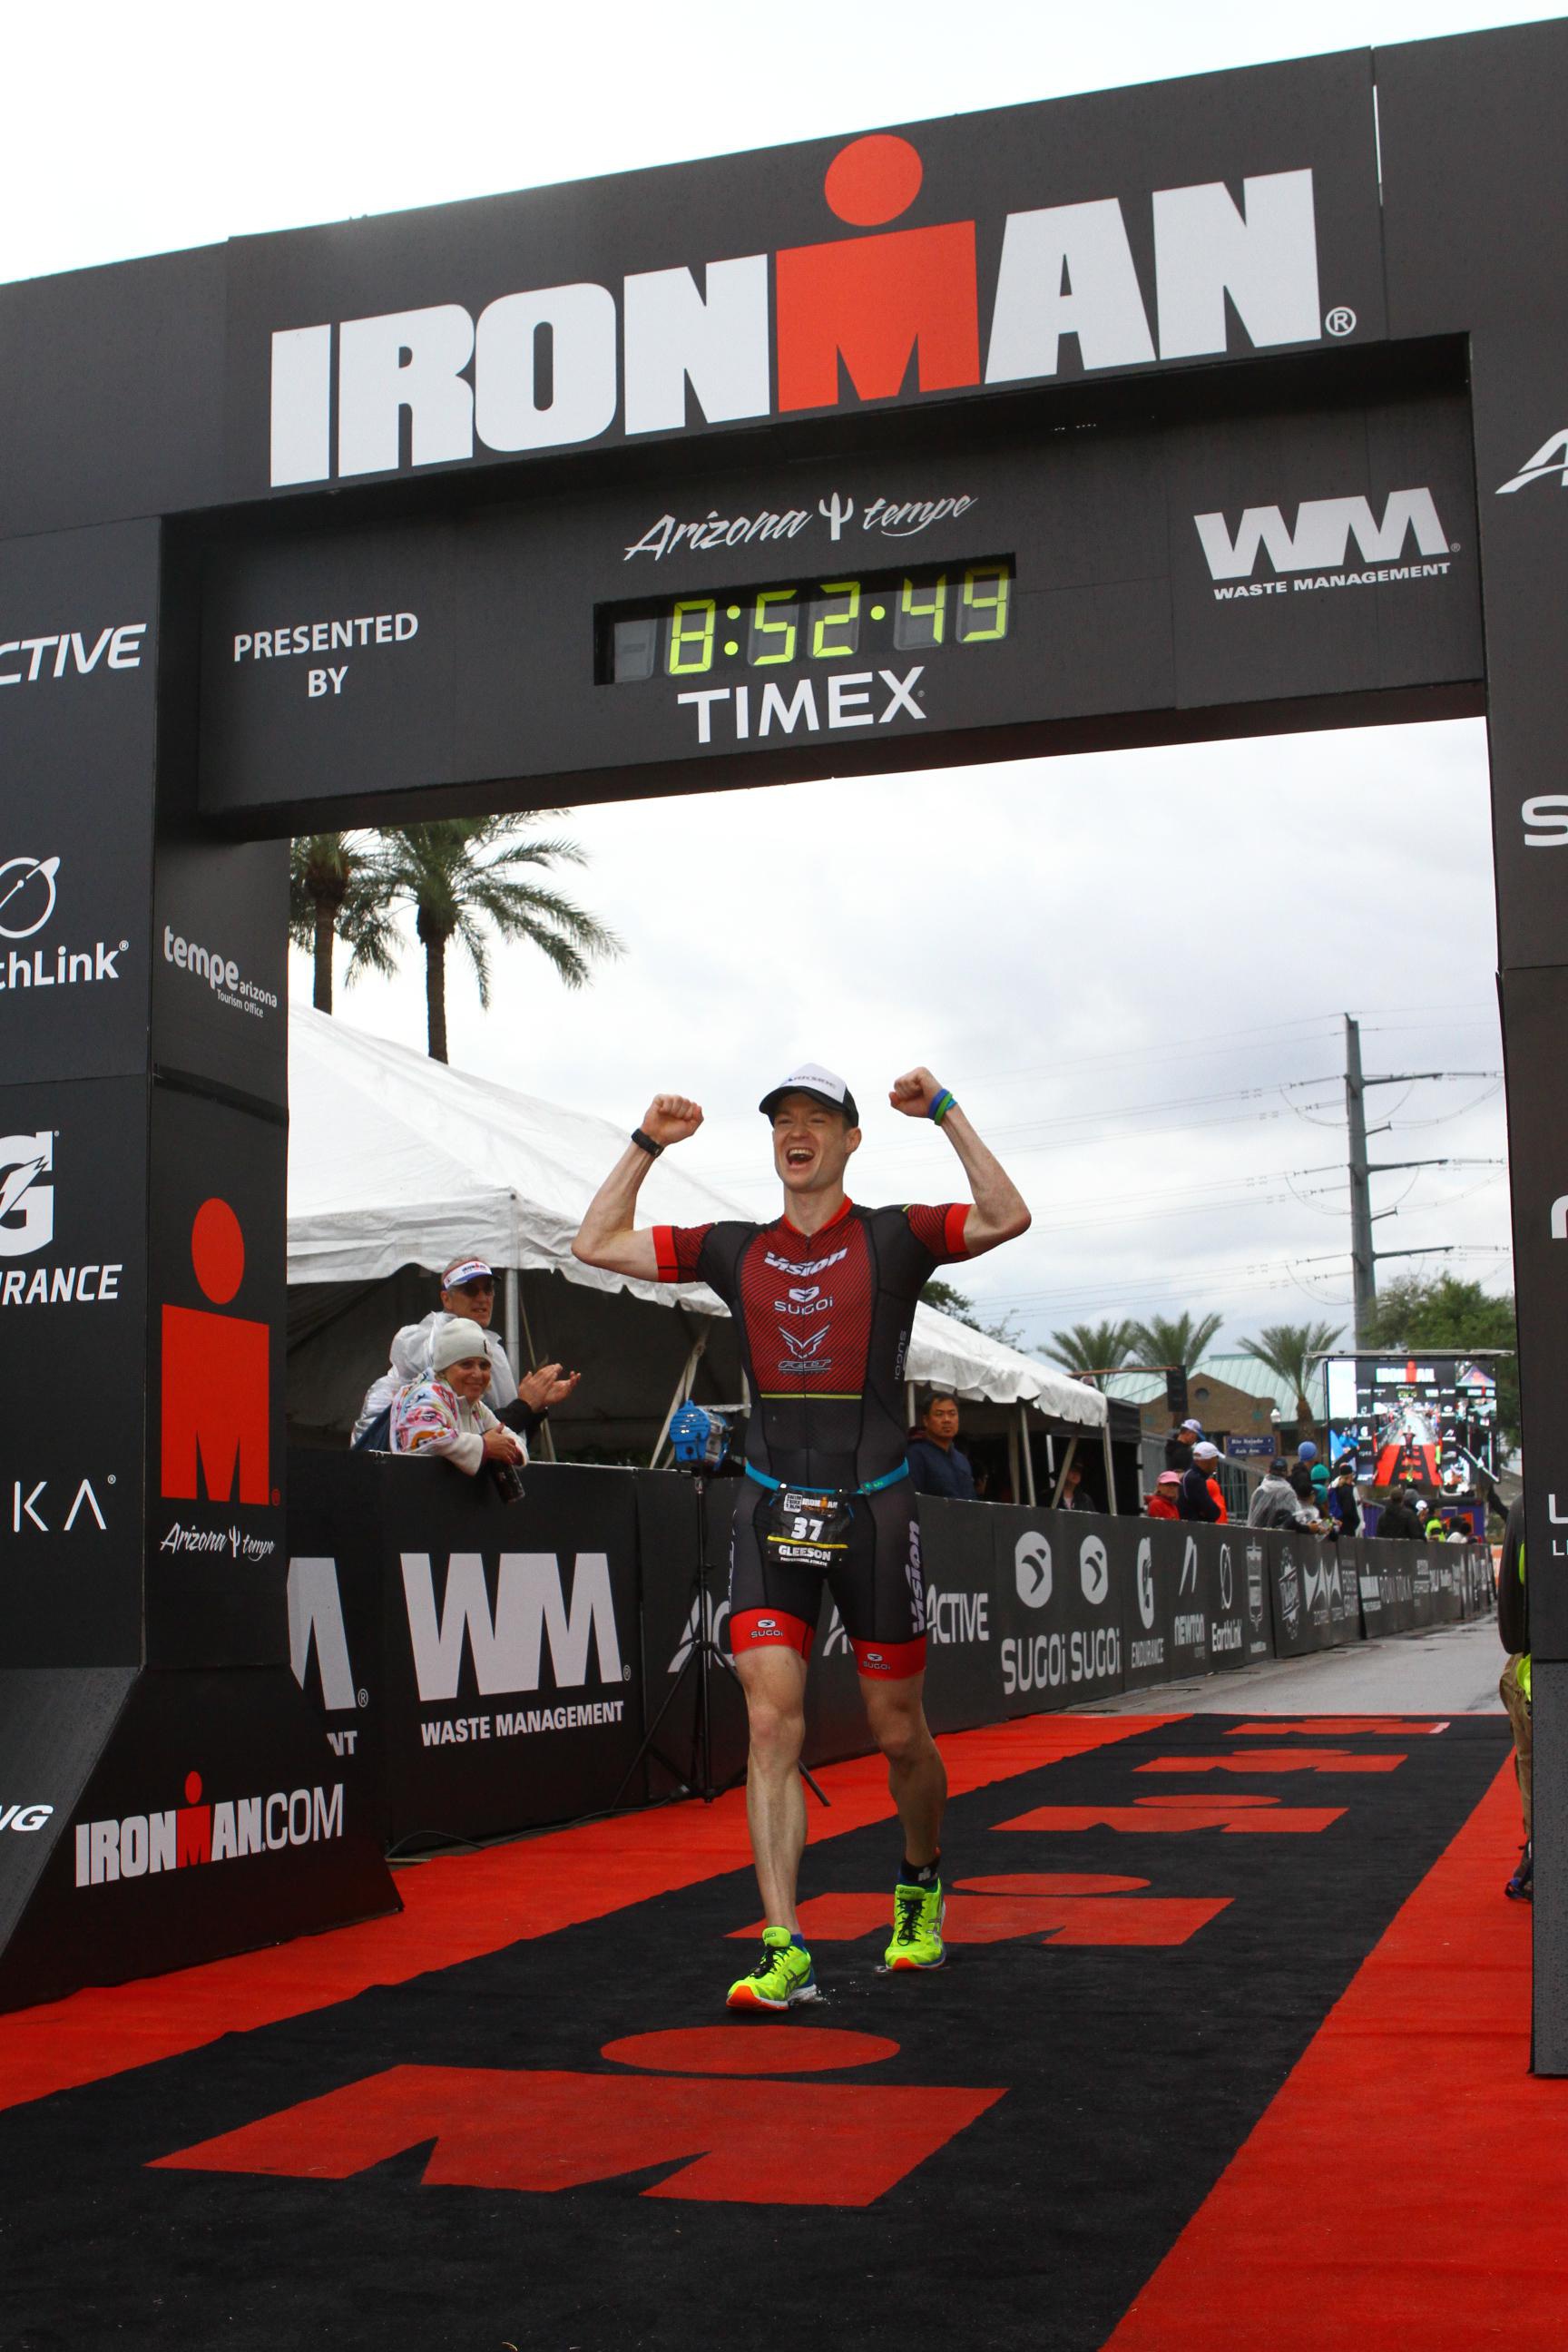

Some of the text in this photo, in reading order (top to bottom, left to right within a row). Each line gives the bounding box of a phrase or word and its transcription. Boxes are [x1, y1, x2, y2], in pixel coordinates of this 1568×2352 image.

[270, 134, 1321, 487] IRONMAN
[622, 495, 979, 561] Arizona tempe
[1213, 562, 1451, 601] WASTE MANAGEMENT
[0, 623, 147, 685] CTIVE
[234, 612, 419, 662] PRESENTED
[308, 666, 348, 698] BY
[677, 665, 926, 744] TIMEX
[163, 925, 278, 1008] tempe arizona
[217, 988, 264, 1019] Tourism Office
[0, 1264, 122, 1306] RANCE
[160, 1522, 275, 1562] Arizona tempe
[778, 1544, 832, 1561] GLEESON
[790, 1516, 825, 1542] 37
[926, 1583, 990, 1645] ACTIVE
[421, 1700, 624, 1747] WASTE MANAGEMENT
[75, 1771, 344, 1888] IRONMAN.COM
